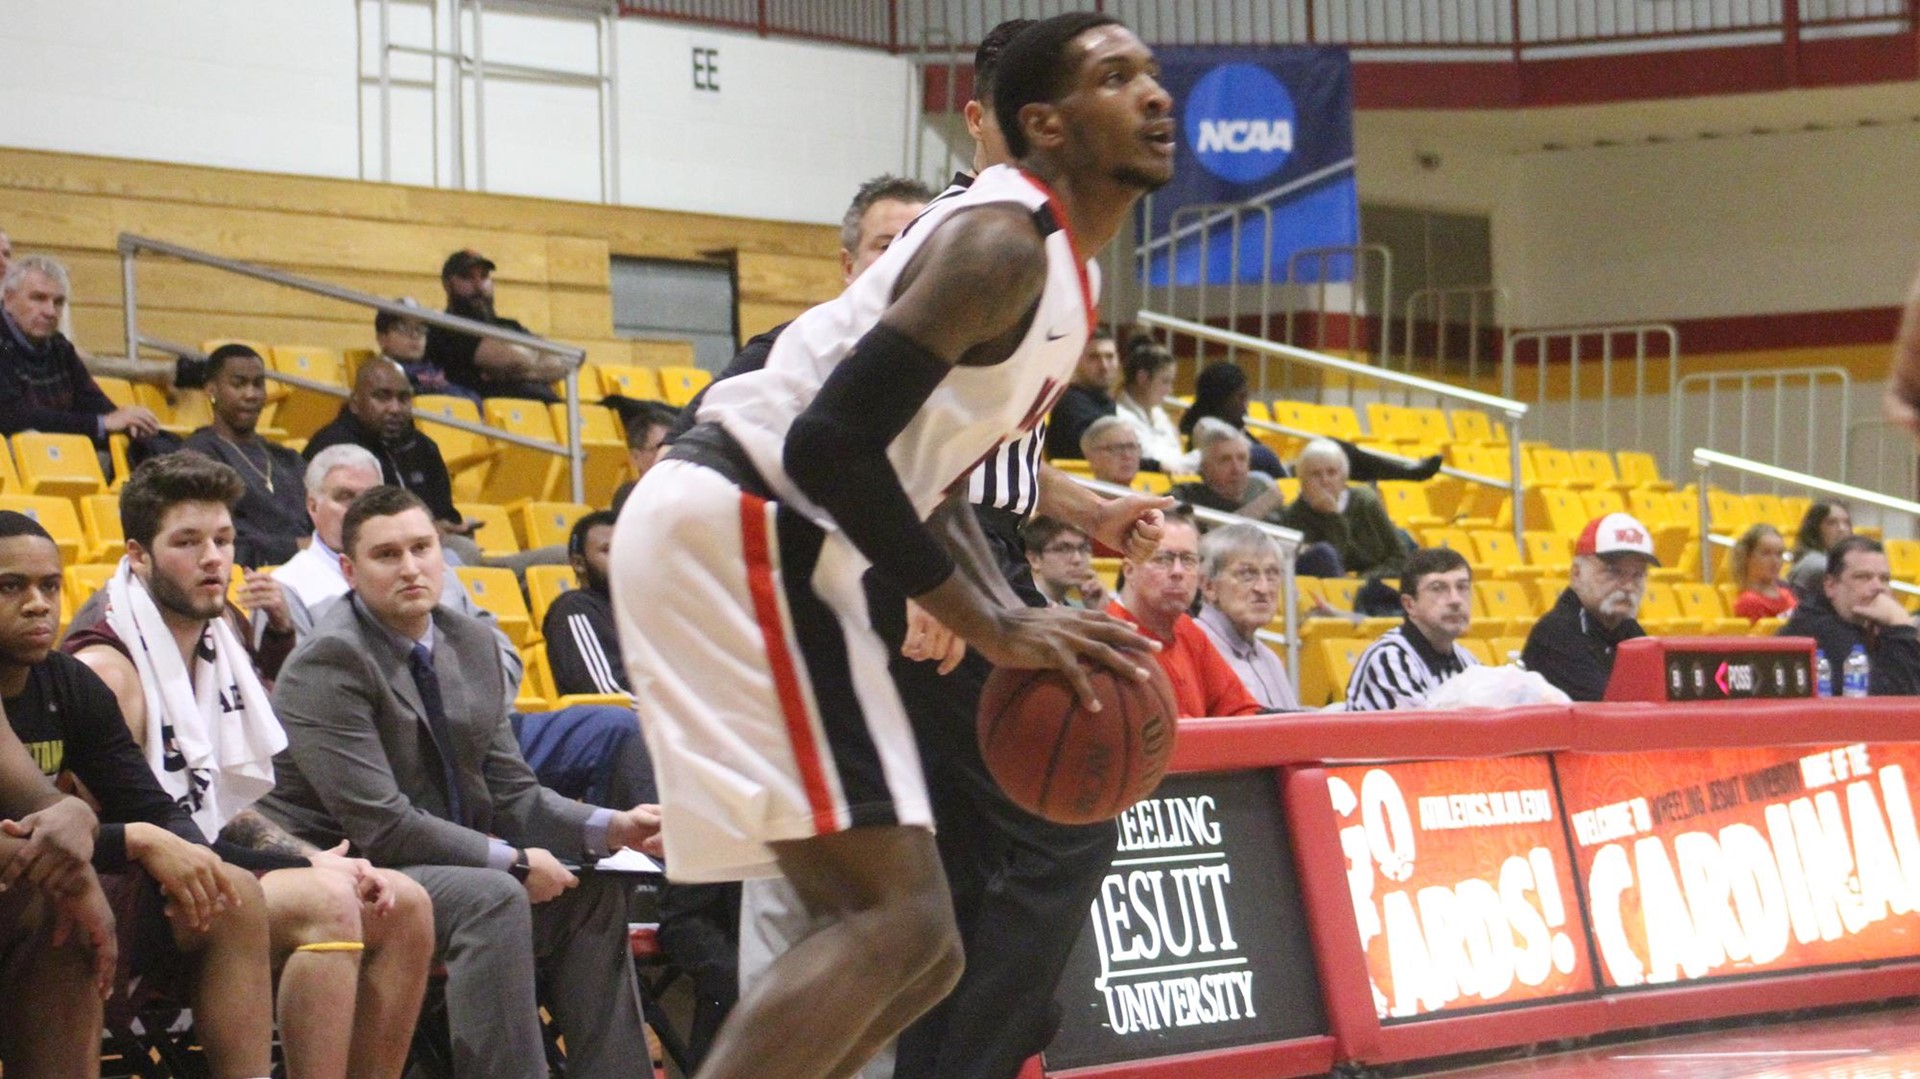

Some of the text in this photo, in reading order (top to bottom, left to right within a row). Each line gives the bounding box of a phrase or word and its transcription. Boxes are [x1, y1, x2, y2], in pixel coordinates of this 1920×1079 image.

[692, 47, 720, 92] EE
[1197, 119, 1293, 153] NCAA
[1728, 664, 1752, 691] POSS
[1651, 785, 1706, 826] WHEELING
[1706, 775, 1743, 812] JESUIT
[1742, 760, 1802, 803] UNIVERSITY
[1091, 863, 1238, 990] JESUIT
[1103, 971, 1257, 1034] UNIVERSITY
